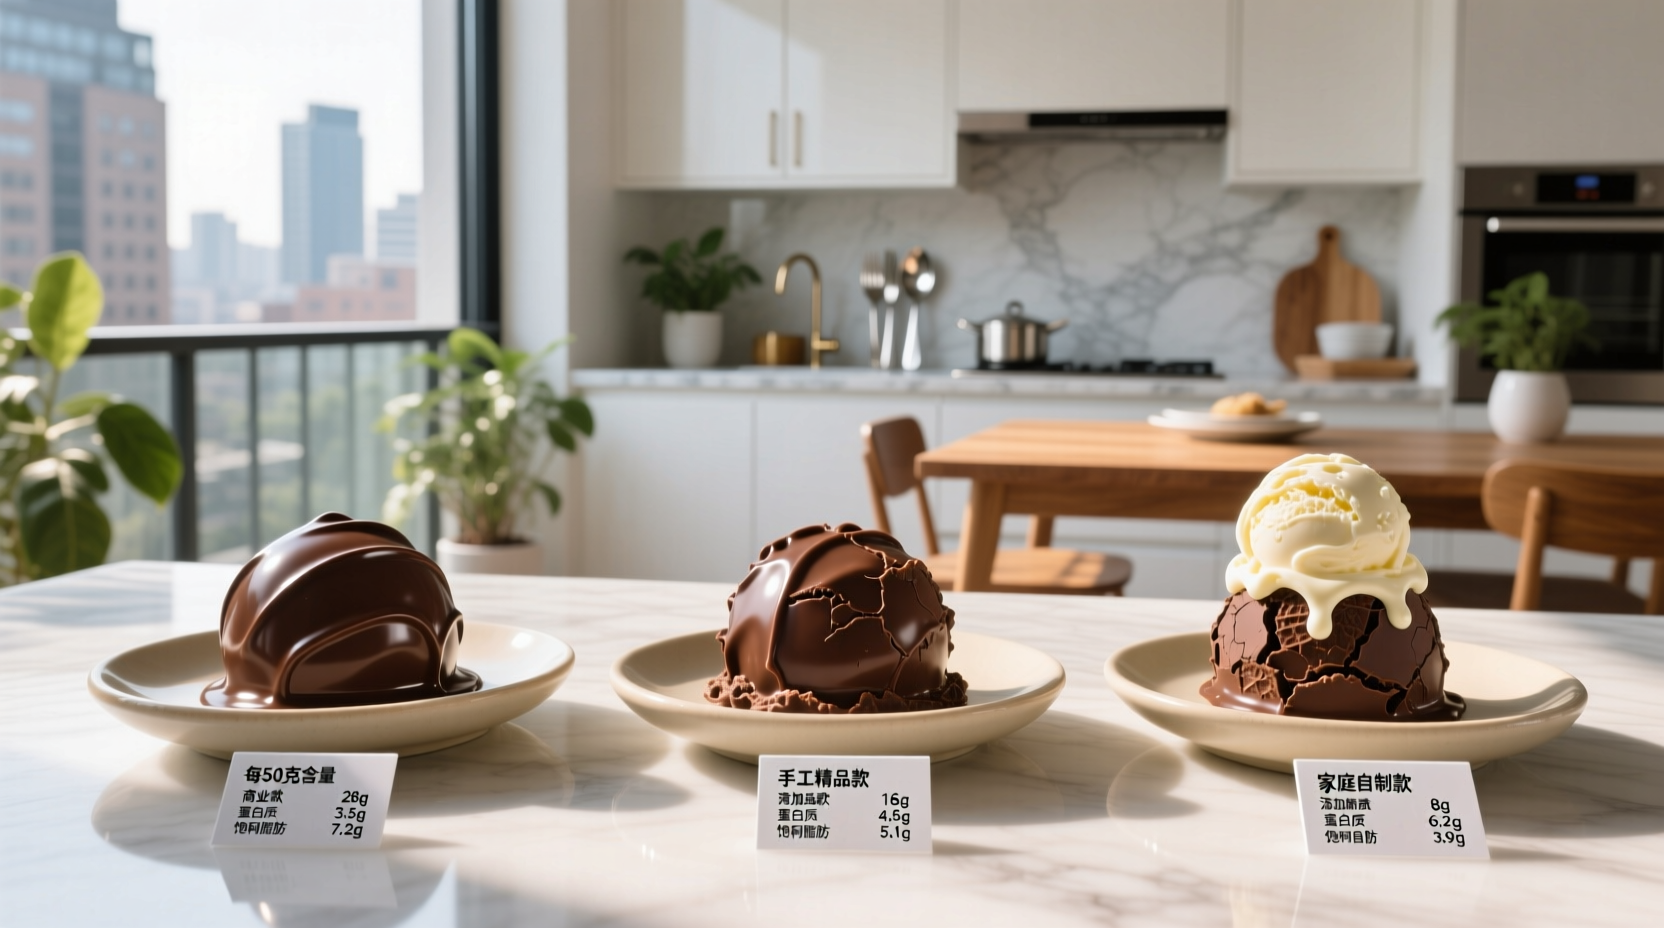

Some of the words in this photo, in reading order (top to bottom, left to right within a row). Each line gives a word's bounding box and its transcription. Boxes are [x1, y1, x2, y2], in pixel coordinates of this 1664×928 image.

[244, 766, 336, 784] 每50克含量
[778, 768, 869, 788] 手工精品款
[1318, 772, 1412, 794] 家庭自制款
[882, 793, 909, 809] 16g
[1431, 798, 1450, 814] 8g
[334, 806, 366, 823] 3.5g
[332, 822, 363, 839] 7.2g
[1429, 815, 1462, 832] 6.2g
[880, 825, 910, 842] 5.1g
[1433, 831, 1465, 847] 3.9g
